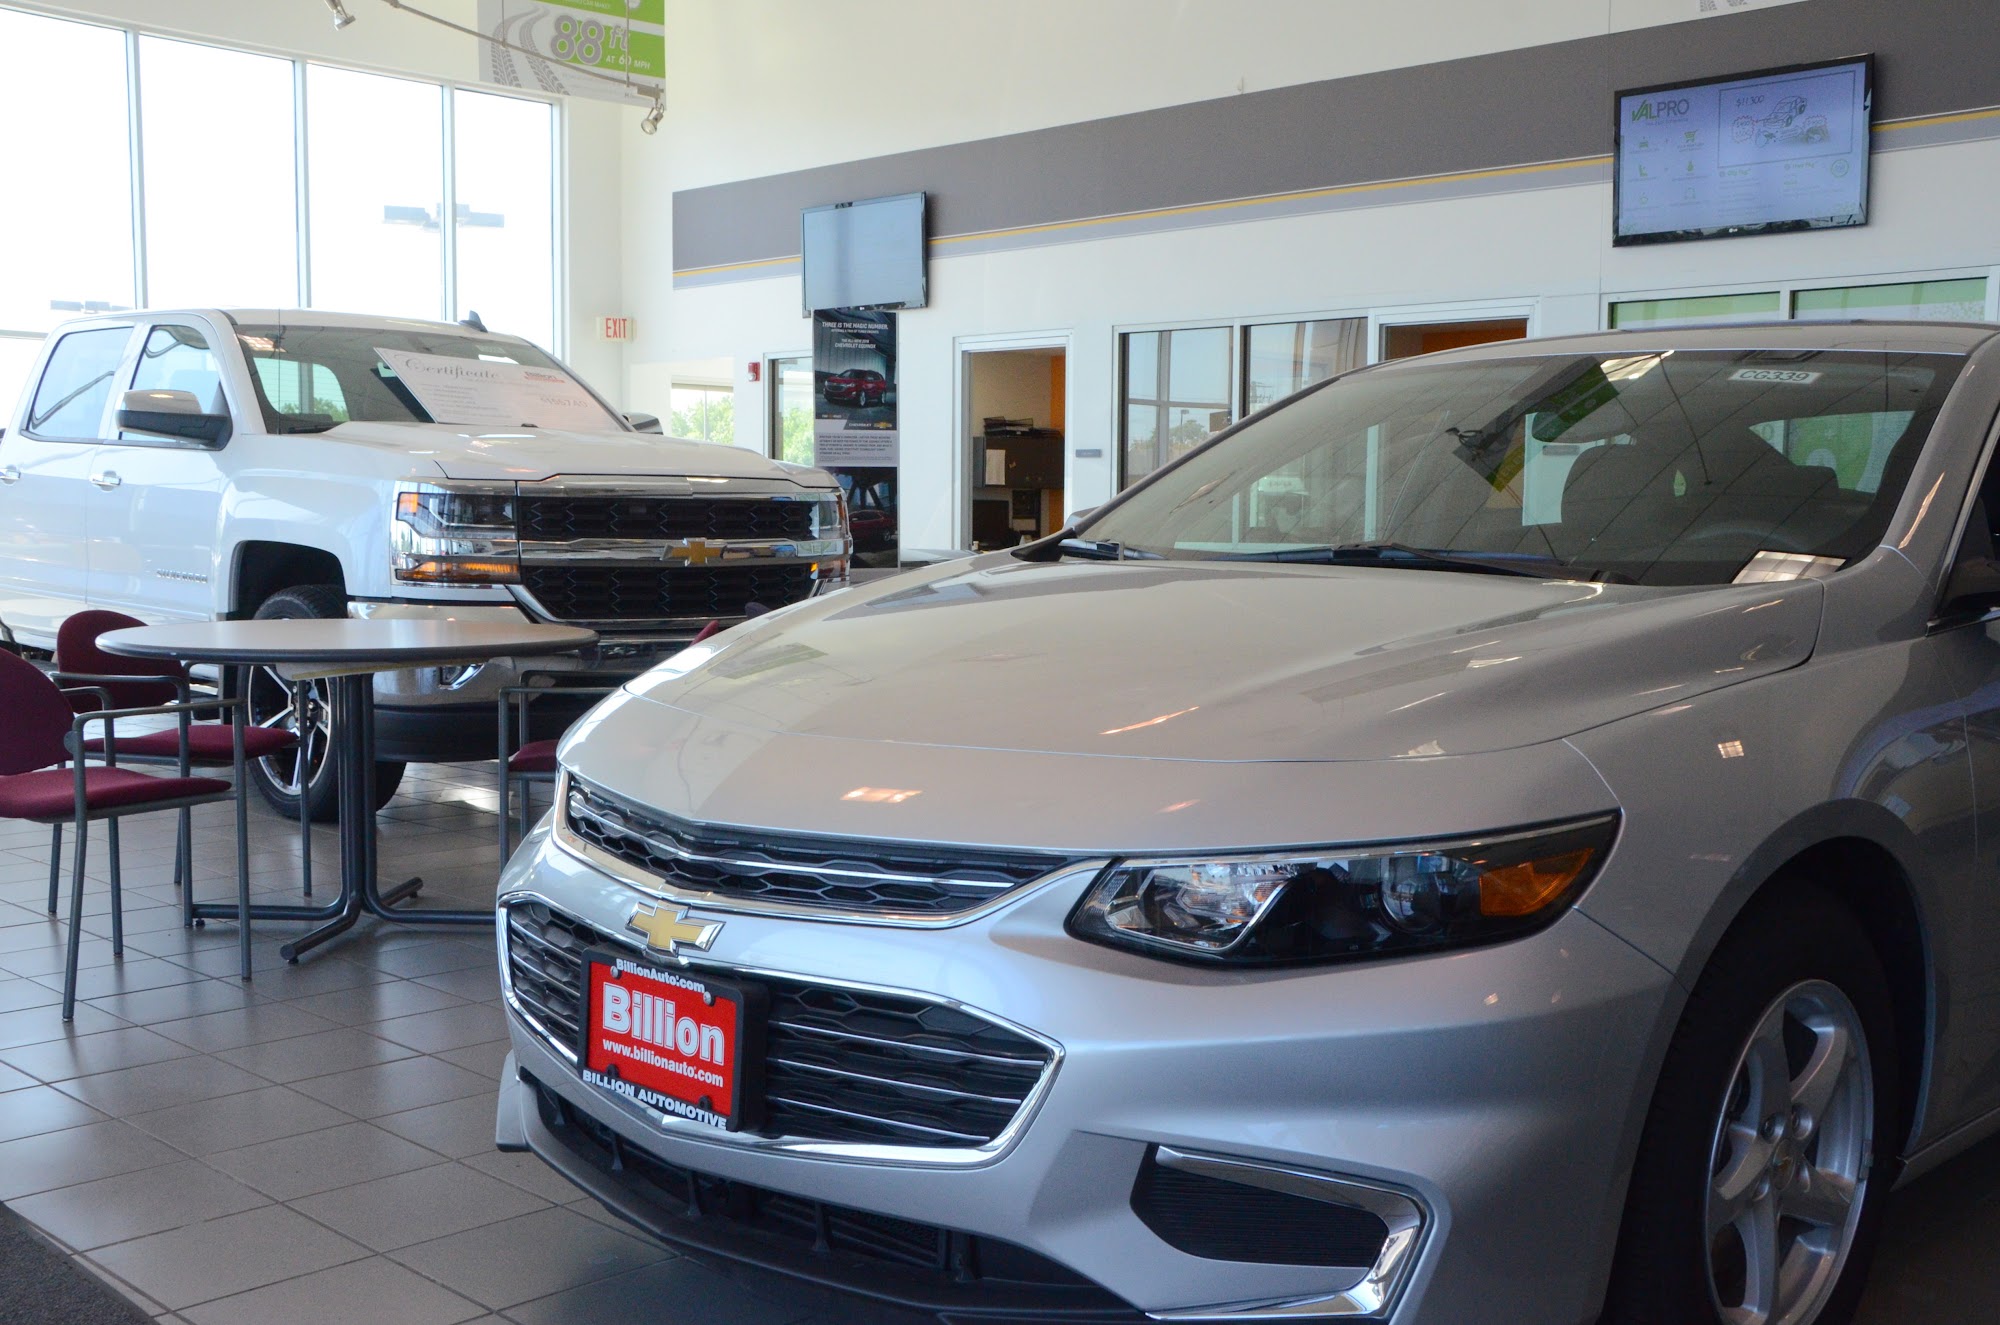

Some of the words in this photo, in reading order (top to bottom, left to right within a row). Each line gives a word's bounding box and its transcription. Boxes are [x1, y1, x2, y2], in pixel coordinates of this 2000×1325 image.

[550, 14, 604, 65] 88
[605, 55, 616, 64] AT
[633, 59, 651, 70] MPH
[605, 317, 628, 339] EXIT
[404, 357, 500, 379] Certificate
[1740, 370, 1810, 381] CG339
[615, 958, 706, 994] BillionAuto.com
[602, 981, 725, 1066] Billion
[602, 1038, 724, 1088] www.billionauto.com
[582, 1069, 635, 1097] BILLION
[637, 1089, 727, 1130] AUTOMOTIVE
